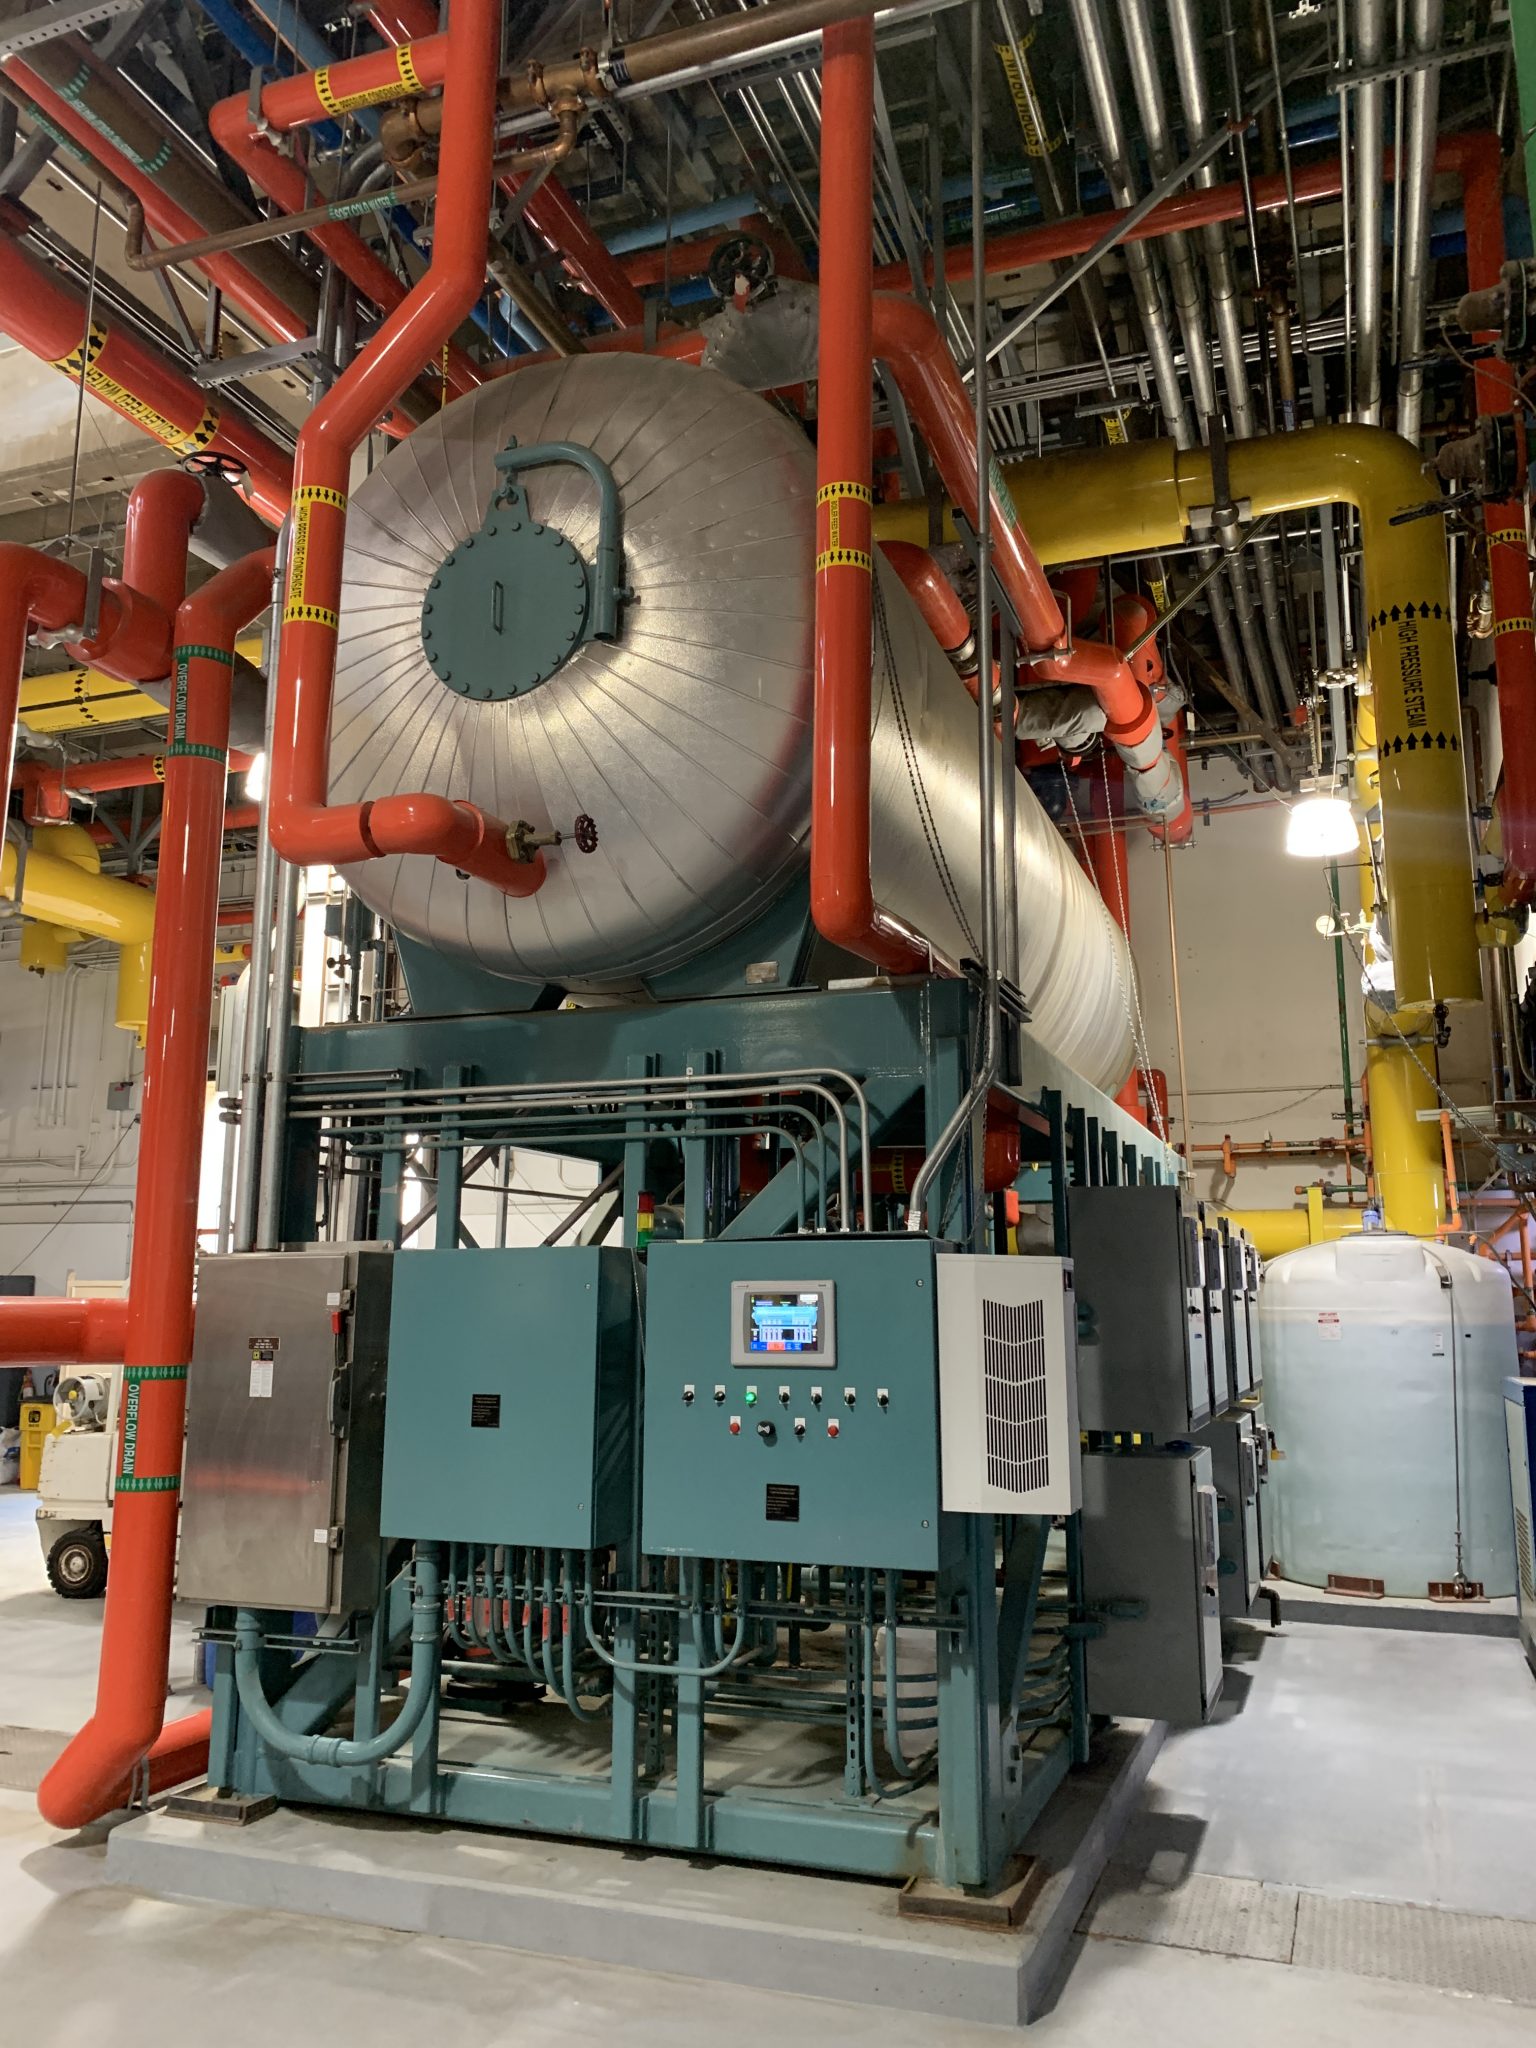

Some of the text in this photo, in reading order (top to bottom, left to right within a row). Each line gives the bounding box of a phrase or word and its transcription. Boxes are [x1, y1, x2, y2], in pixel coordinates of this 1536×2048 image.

[350, 201, 370, 216] COLD
[368, 196, 392, 211] WATER
[85, 367, 181, 440] BOILER FEED WATER
[290, 505, 308, 599] HIGH PRESSURE CONDENSATE
[174, 663, 188, 739] OVERFLOW DRAIN
[1398, 619, 1428, 729] HIGH PRESSURE STEAM
[122, 1384, 140, 1474] OVERFLOW DRAIN
